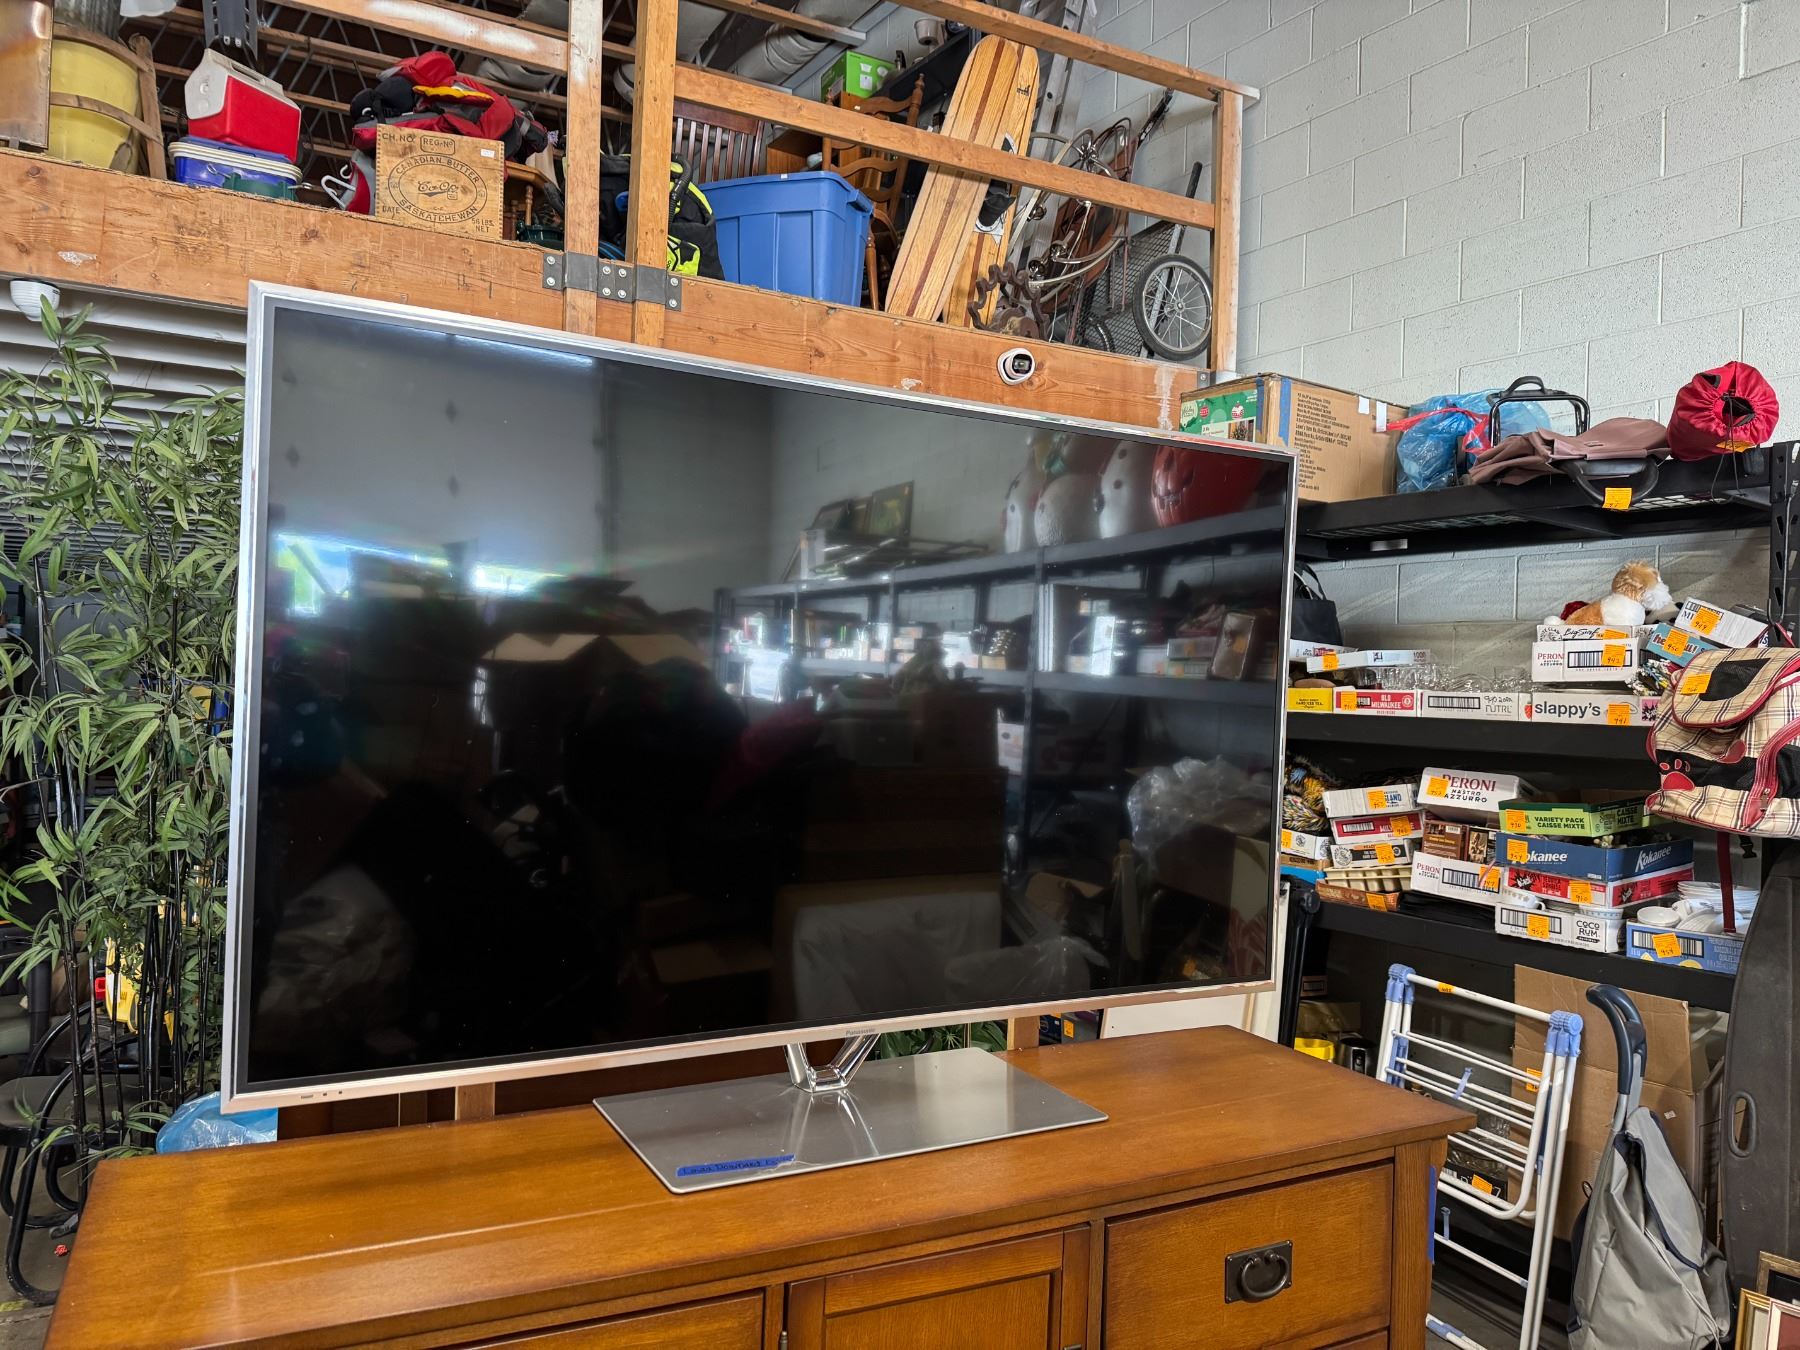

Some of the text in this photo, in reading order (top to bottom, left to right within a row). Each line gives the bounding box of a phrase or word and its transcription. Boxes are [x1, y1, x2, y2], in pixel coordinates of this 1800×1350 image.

[396, 156, 480, 183] CANADIAN BUTTER
[382, 205, 401, 214] DATE
[399, 199, 478, 223] SASKATCHEWAN
[1380, 694, 1391, 702] OLD
[1371, 701, 1402, 709] MILWAUKEE
[1534, 701, 1601, 718] slappy's
[1444, 793, 1488, 803] AZZURRO
[1617, 806, 1638, 816] CAISSE
[1566, 816, 1585, 824] PACK
[1617, 815, 1634, 825] MIXTE
[1635, 846, 1672, 873] Kokanee
[1576, 920, 1600, 931] COCO
[1579, 928, 1598, 937] RUM
